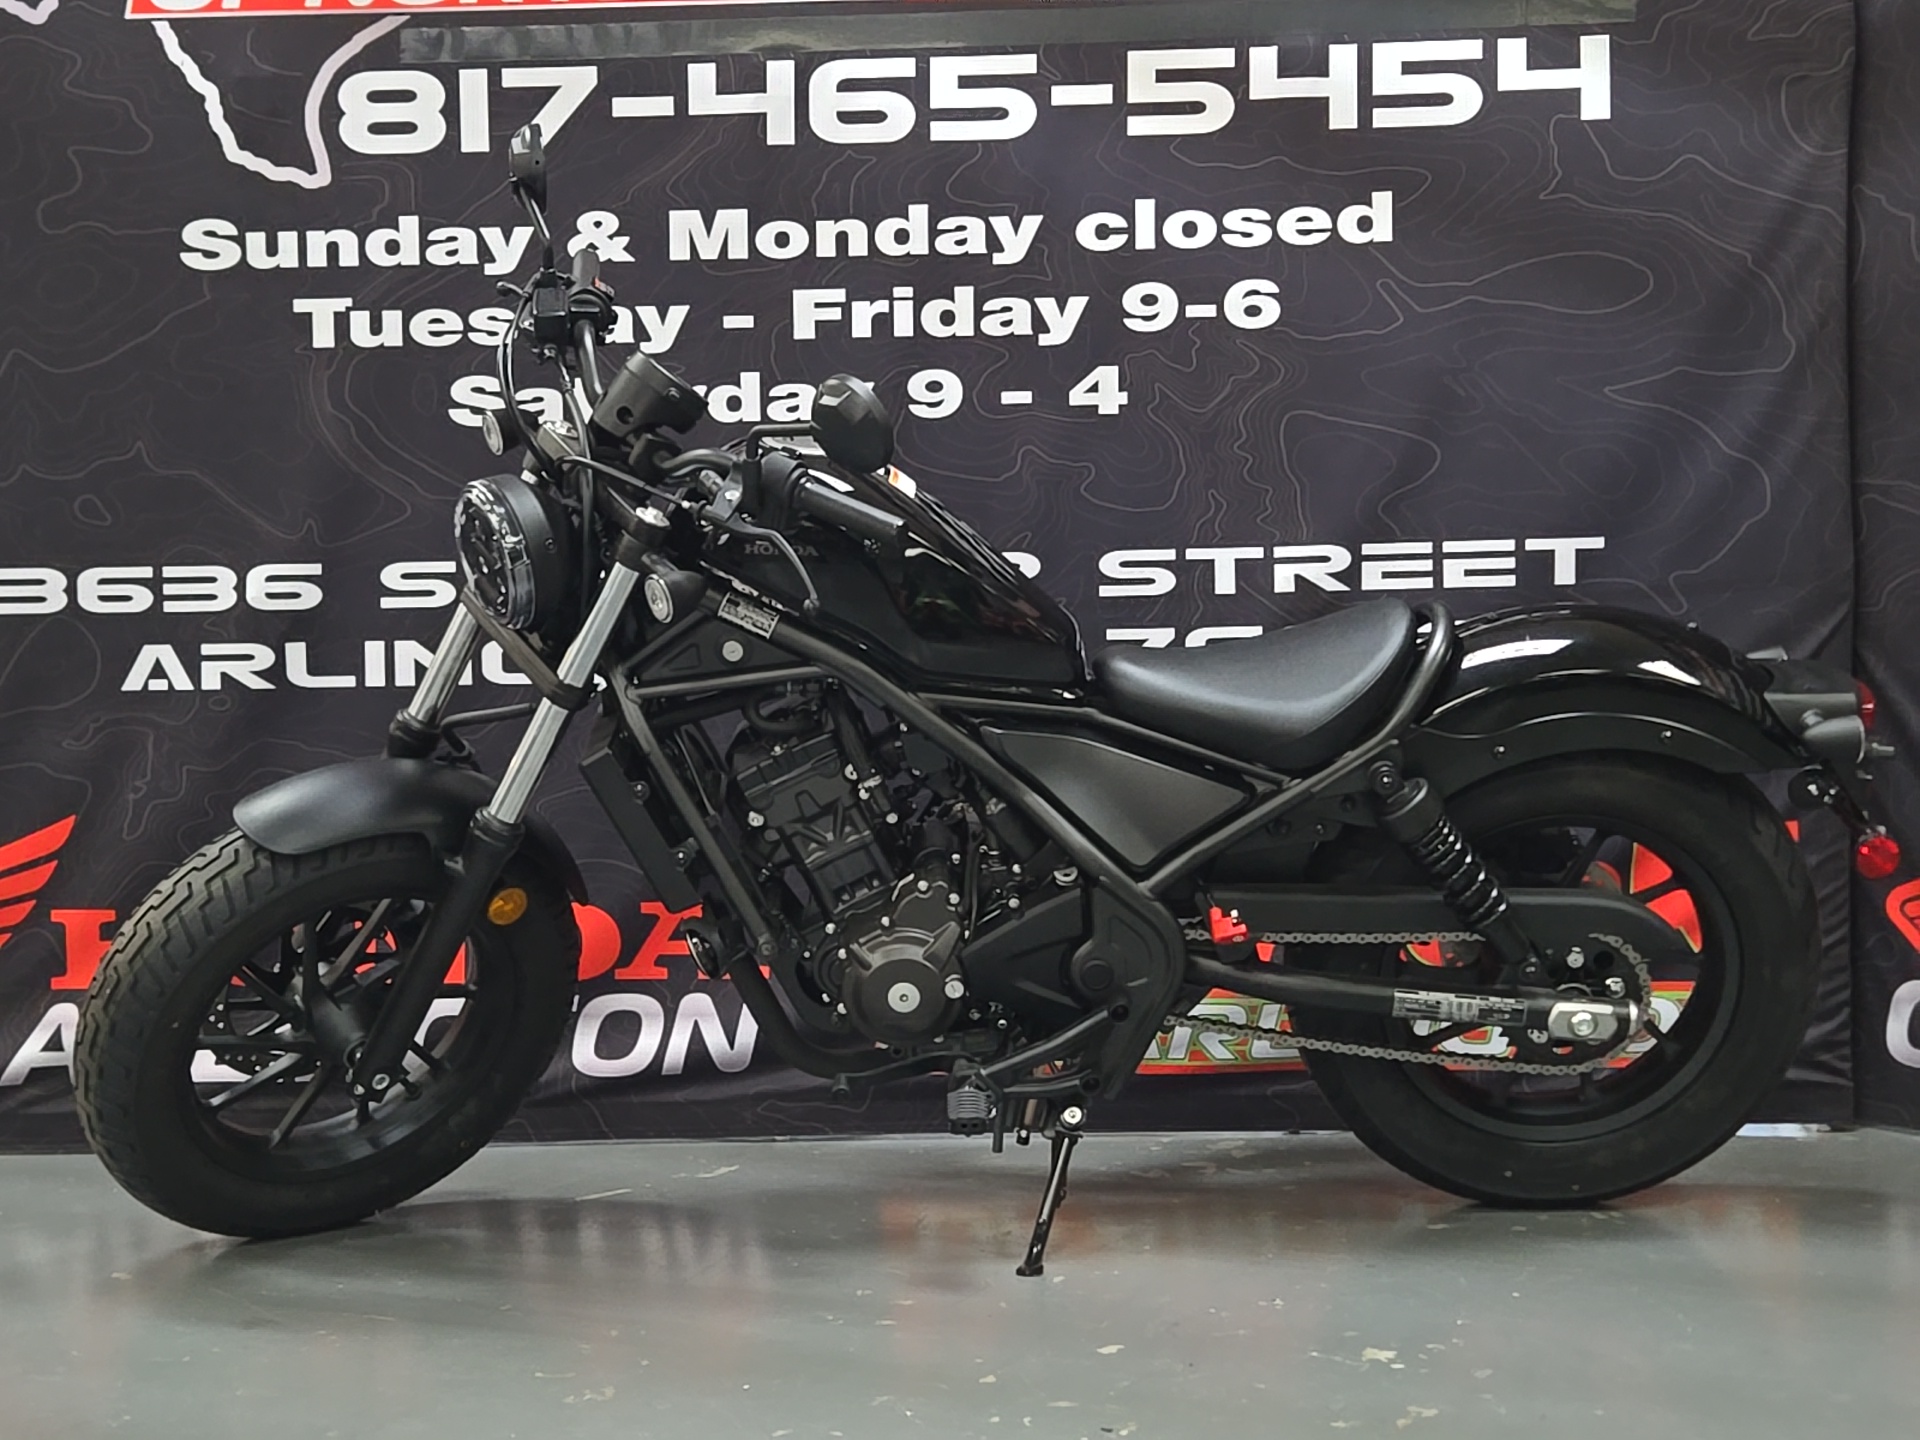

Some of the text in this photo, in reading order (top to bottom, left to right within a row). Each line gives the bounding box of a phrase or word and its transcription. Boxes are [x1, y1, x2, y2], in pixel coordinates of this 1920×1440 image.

[337, 34, 1611, 155] 817-465-5454
[180, 191, 1393, 275] Sunday & Monday closed
[293, 279, 1281, 354] Tuesay - Friday 9-6
[907, 370, 963, 419] 9
[1068, 366, 1128, 415] 4
[0, 563, 322, 615] 3636
[1098, 536, 1605, 597] STREET
